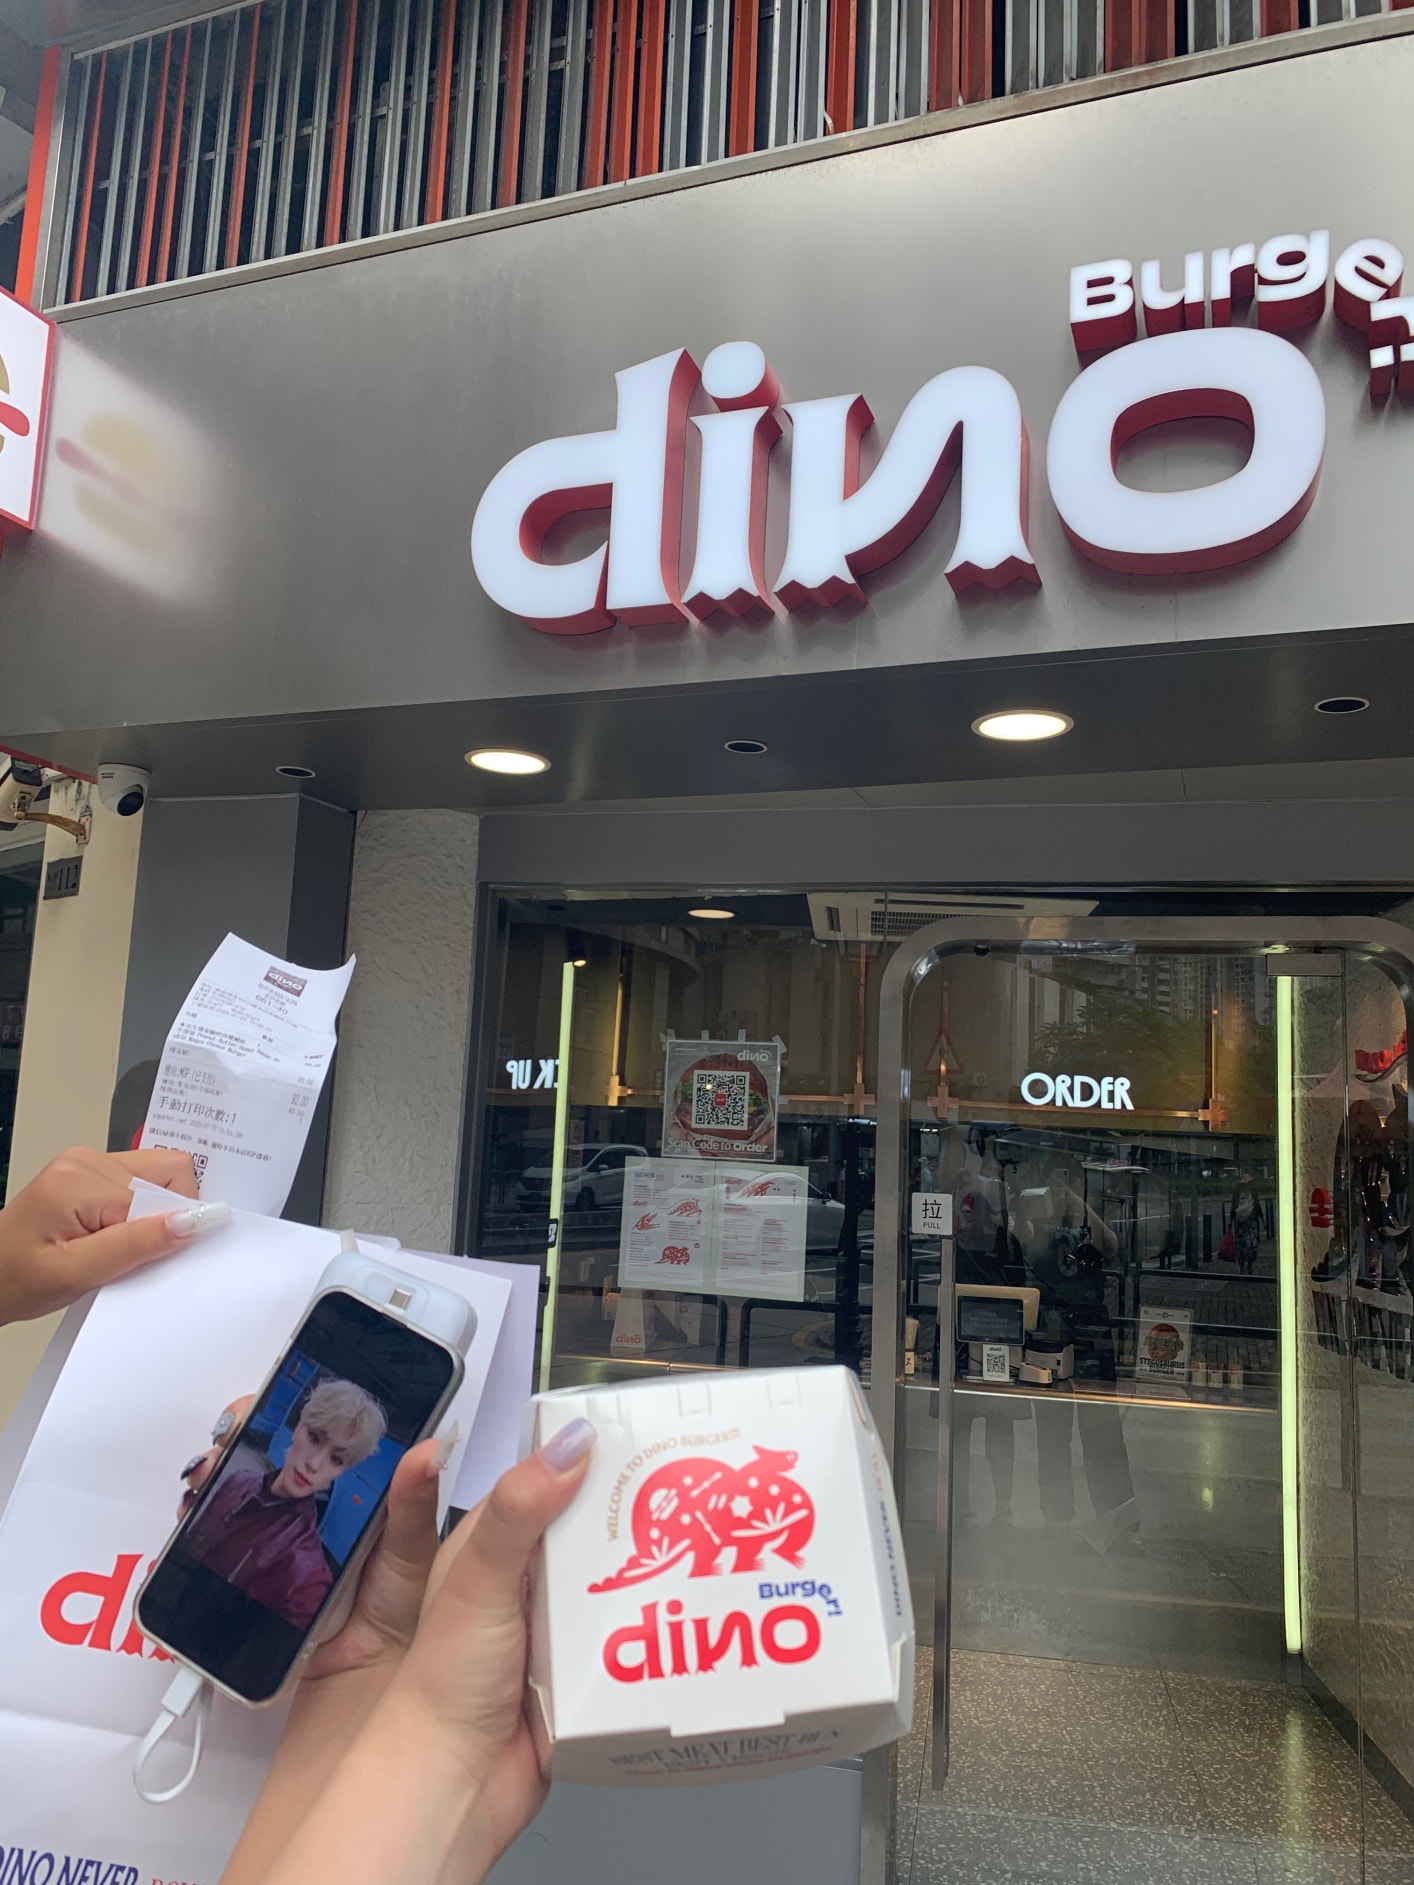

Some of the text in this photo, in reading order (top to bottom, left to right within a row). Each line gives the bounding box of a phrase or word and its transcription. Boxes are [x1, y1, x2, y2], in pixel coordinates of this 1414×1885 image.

[471, 326, 1326, 624] dino
[736, 1050, 769, 1062] dino
[1020, 1071, 1134, 1110] ORDER
[667, 1137, 768, 1153] Scan Code to Order
[921, 1198, 943, 1220] 拉
[922, 1221, 941, 1230] PULL
[607, 1471, 631, 1543] WELCOME
[625, 1454, 644, 1473] TO
[643, 1436, 678, 1460] DINO
[602, 1597, 822, 1685] dino
